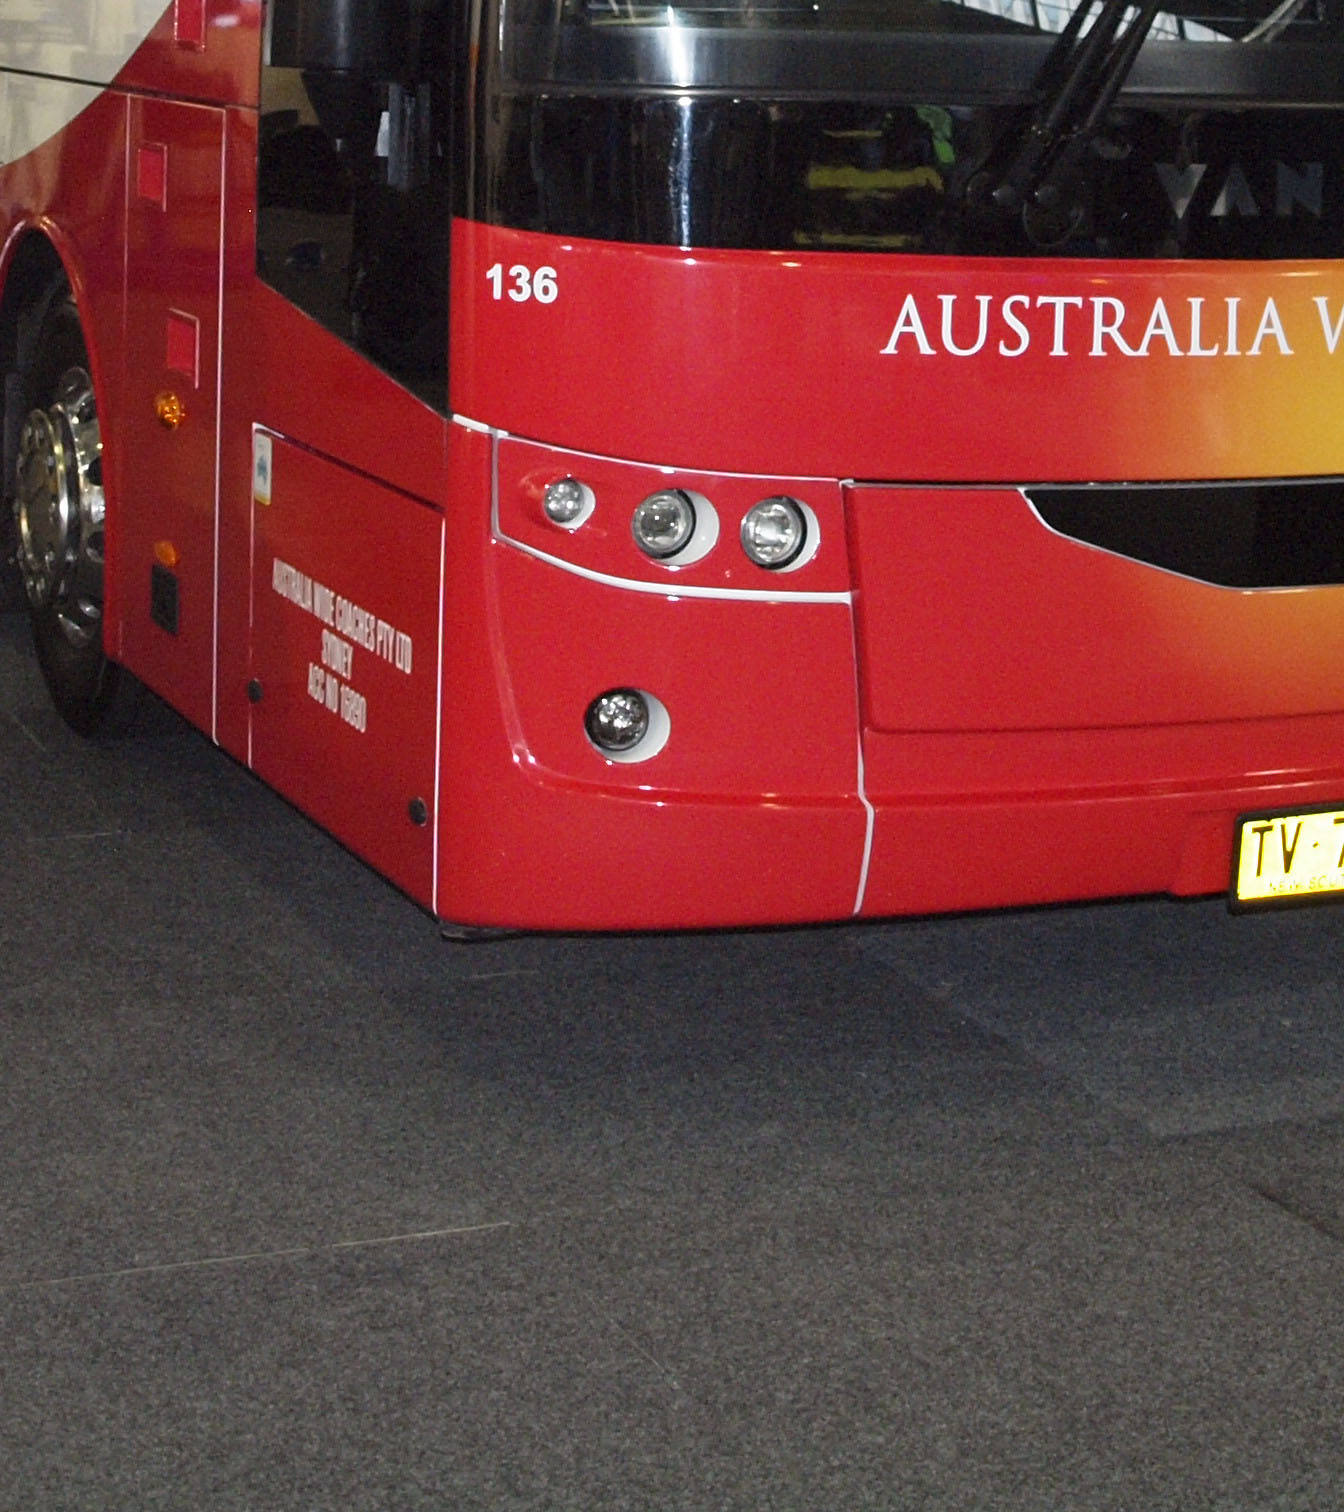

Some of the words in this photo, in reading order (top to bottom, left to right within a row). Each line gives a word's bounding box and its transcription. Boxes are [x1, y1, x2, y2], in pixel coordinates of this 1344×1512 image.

[485, 262, 558, 305] 136
[881, 292, 1294, 358] AUSTRALIA
[336, 595, 376, 652] COACHES
[376, 619, 395, 664] PTY
[396, 630, 413, 676] LTD
[1252, 823, 1302, 877] TV
